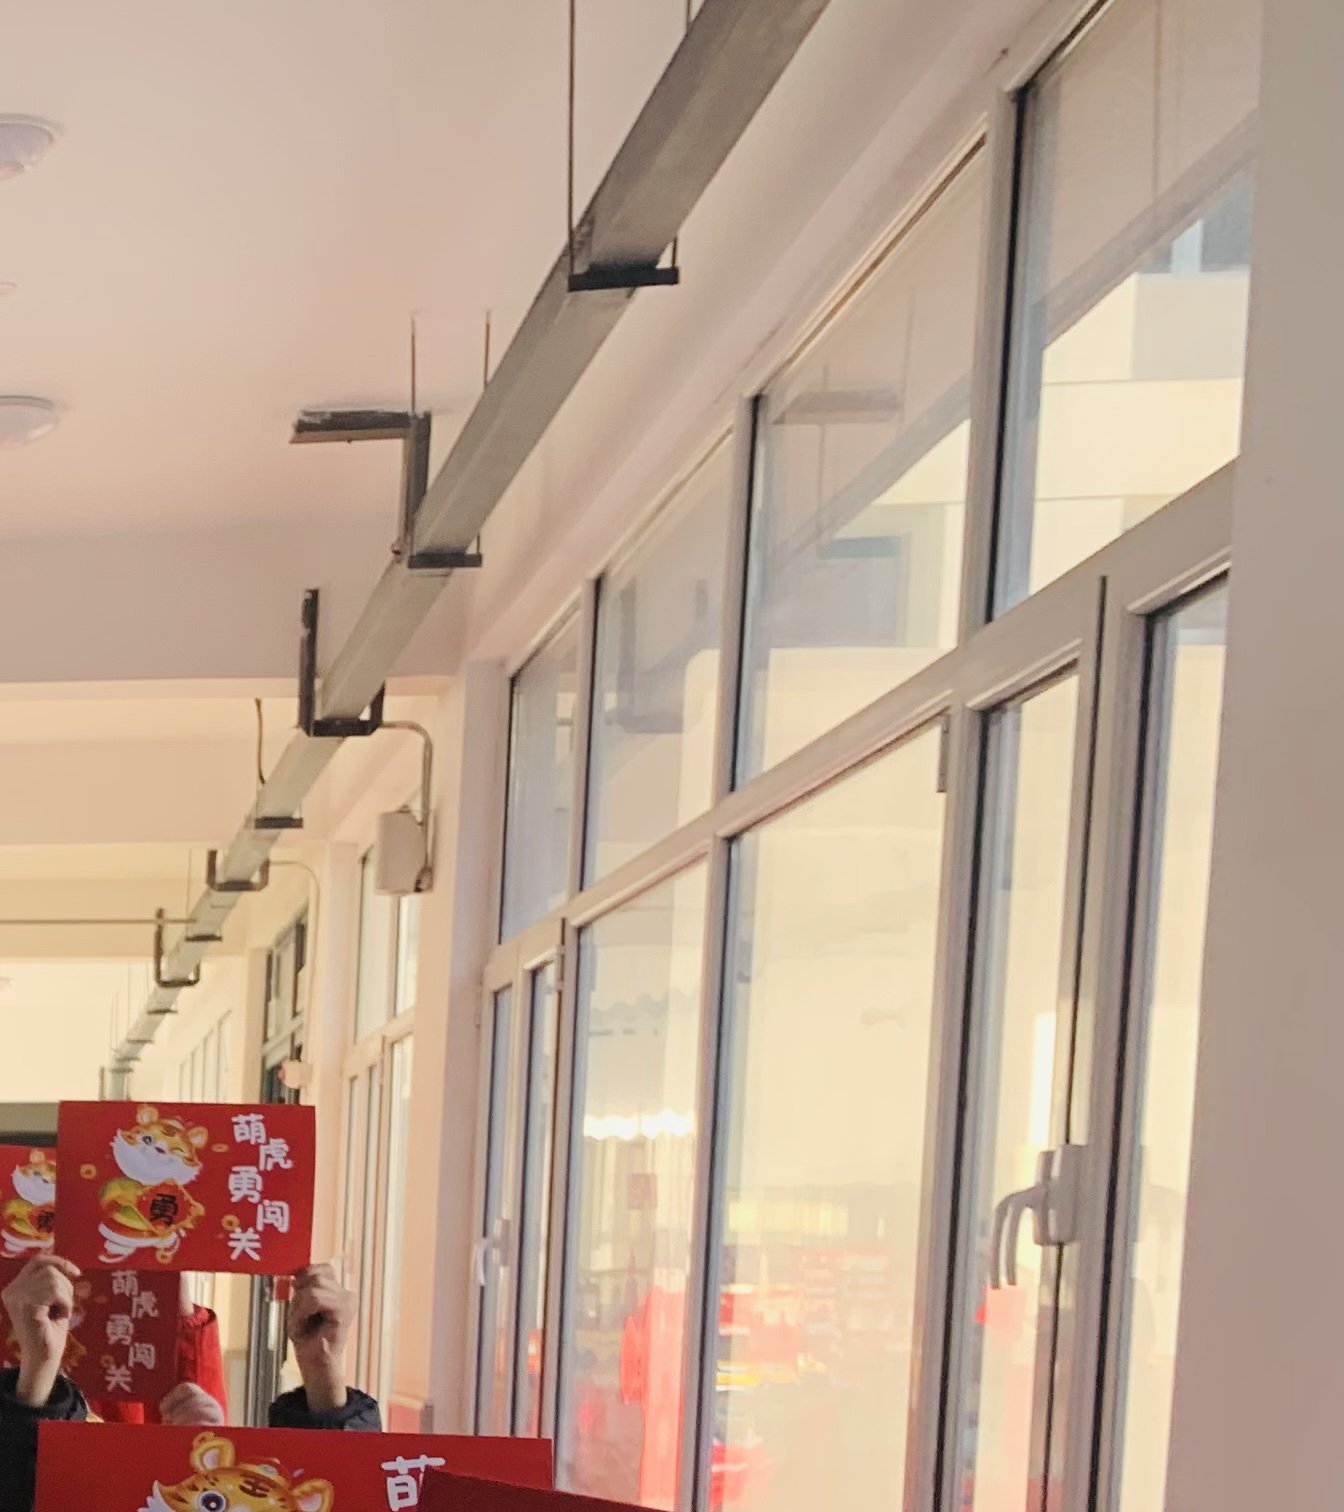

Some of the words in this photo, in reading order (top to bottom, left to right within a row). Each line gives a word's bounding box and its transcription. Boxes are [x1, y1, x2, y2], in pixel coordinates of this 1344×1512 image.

[228, 1112, 293, 1261] 萌虎勇闯关
